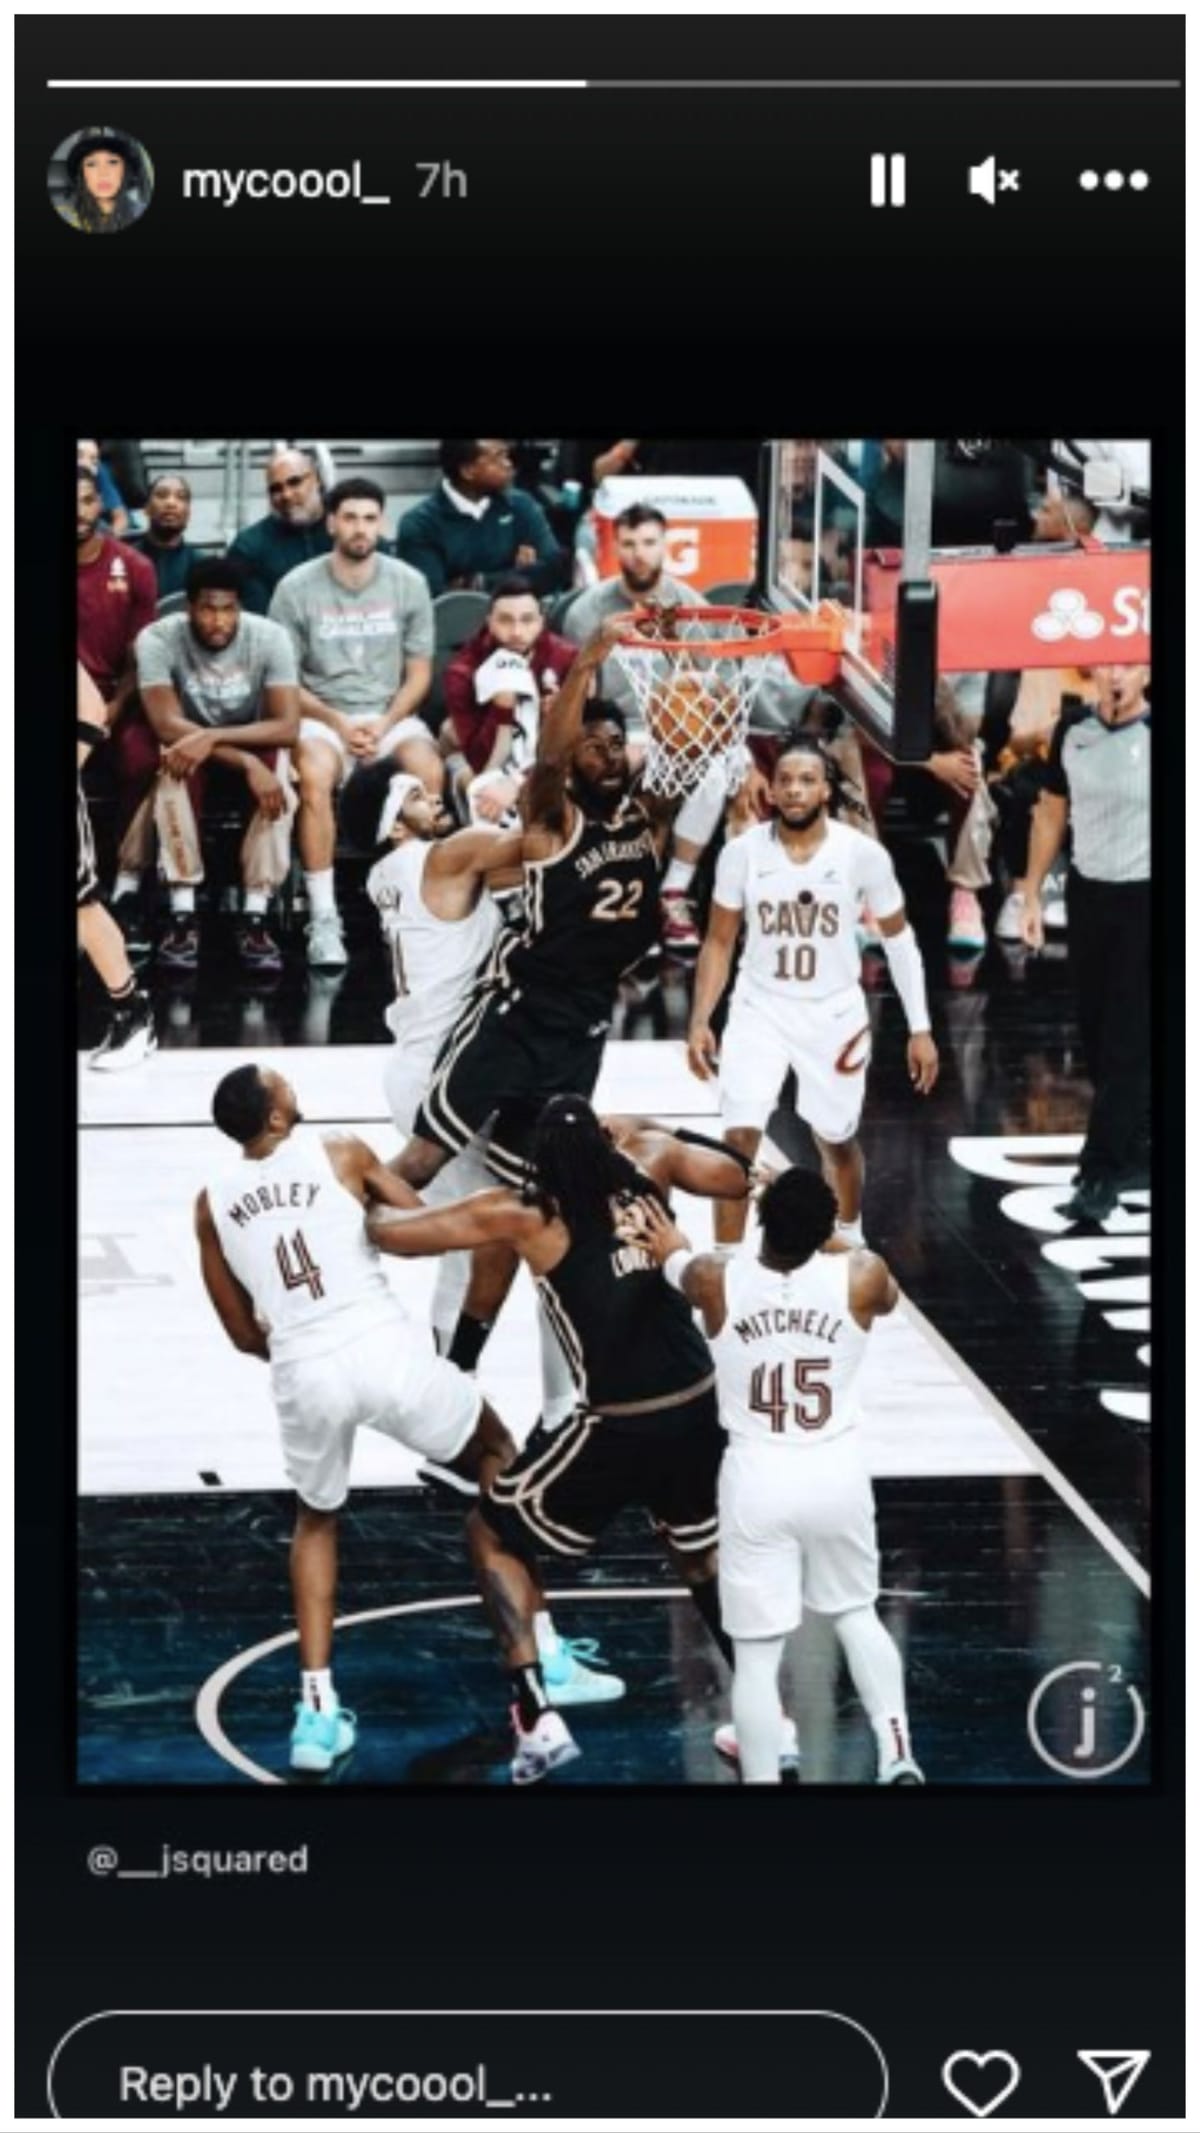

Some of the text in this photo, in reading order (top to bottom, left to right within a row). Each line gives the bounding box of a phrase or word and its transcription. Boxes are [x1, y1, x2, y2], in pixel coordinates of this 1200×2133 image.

[662, 528, 702, 576] G
[590, 878, 644, 920] 22
[757, 899, 840, 938] CAVS
[774, 944, 817, 981] 10
[227, 1182, 322, 1229] MOBLEY
[274, 1228, 326, 1301] 4
[732, 1308, 844, 1344] MITCHELL
[748, 1357, 833, 1434] 45
